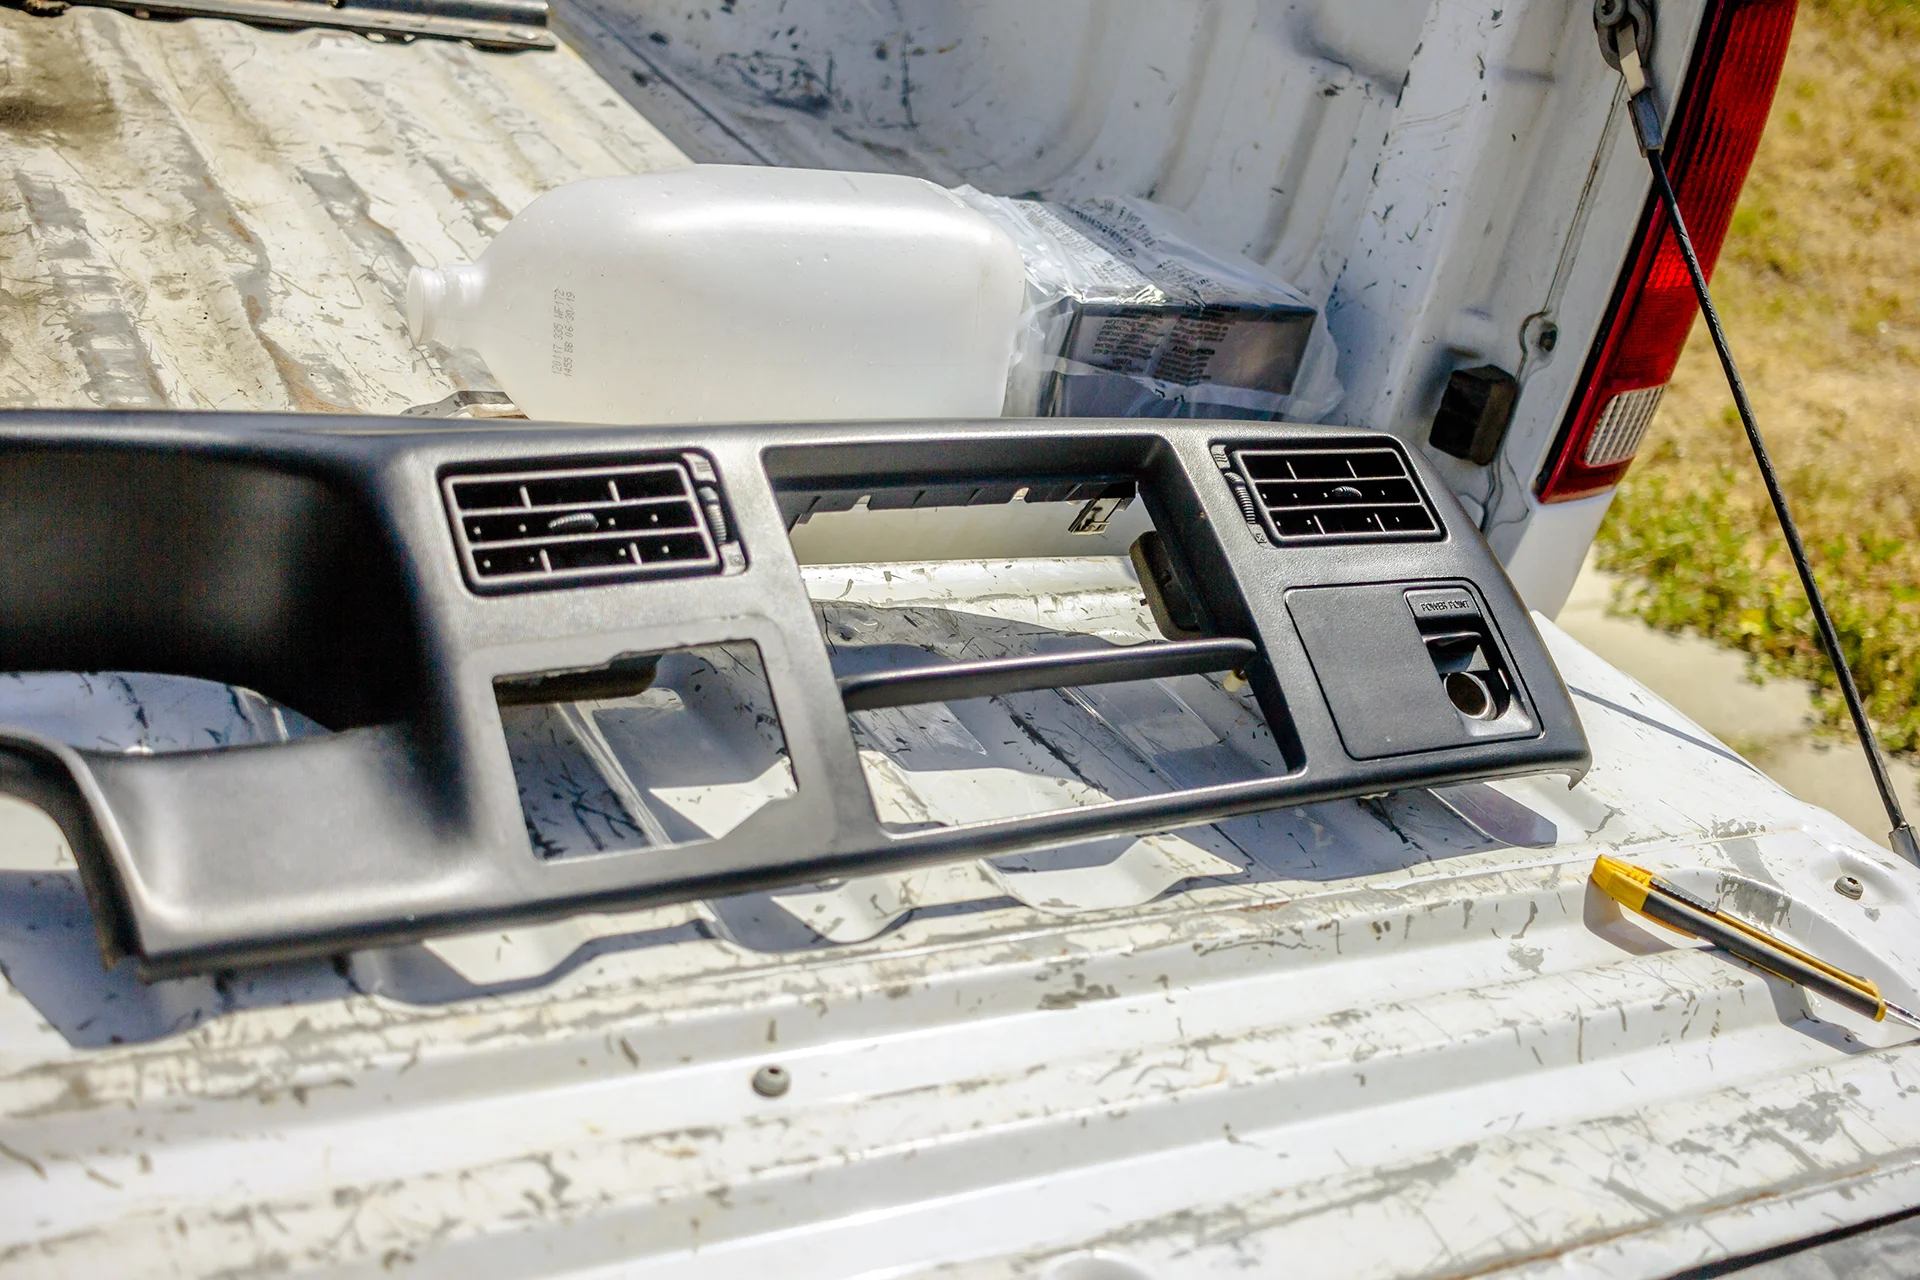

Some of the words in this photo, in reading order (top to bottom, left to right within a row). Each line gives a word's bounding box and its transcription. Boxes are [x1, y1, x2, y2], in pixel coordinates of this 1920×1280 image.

[565, 291, 576, 338] 06/30/19
[553, 322, 564, 341] 335
[552, 344, 563, 375] 120117
[563, 357, 573, 377] 1455
[1421, 601, 1448, 611] POWER
[1447, 600, 1470, 610] POINT
